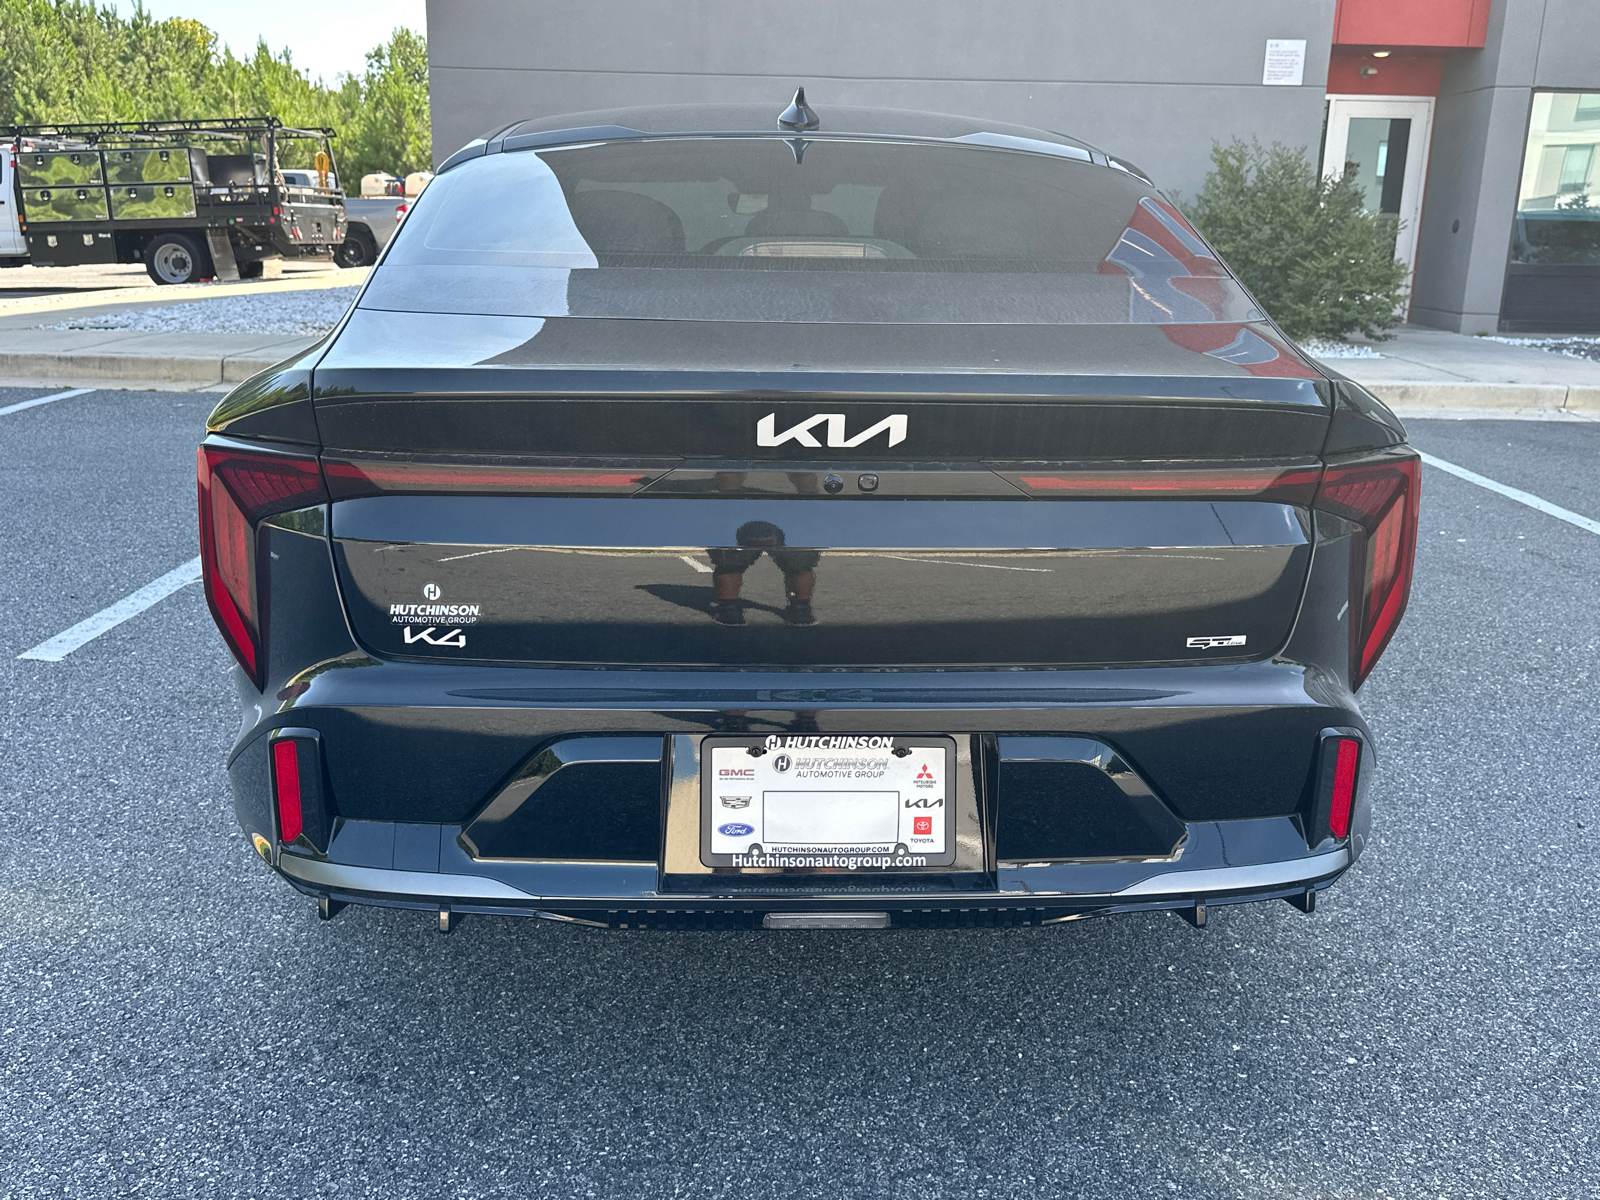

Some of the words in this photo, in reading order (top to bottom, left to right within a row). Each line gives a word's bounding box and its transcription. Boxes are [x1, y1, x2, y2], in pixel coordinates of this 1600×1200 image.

[756, 412, 908, 448] KIA
[392, 616, 446, 624] AUTOMOTIVE
[403, 626, 466, 648] K4
[784, 736, 894, 750] HUTCHINSON
[795, 770, 853, 779] AUTOMOTIVE
[854, 770, 885, 779] GROUP
[905, 798, 944, 809] KIA
[724, 824, 748, 835] Ford
[732, 854, 927, 870] Hutchinsonautogroup.com
